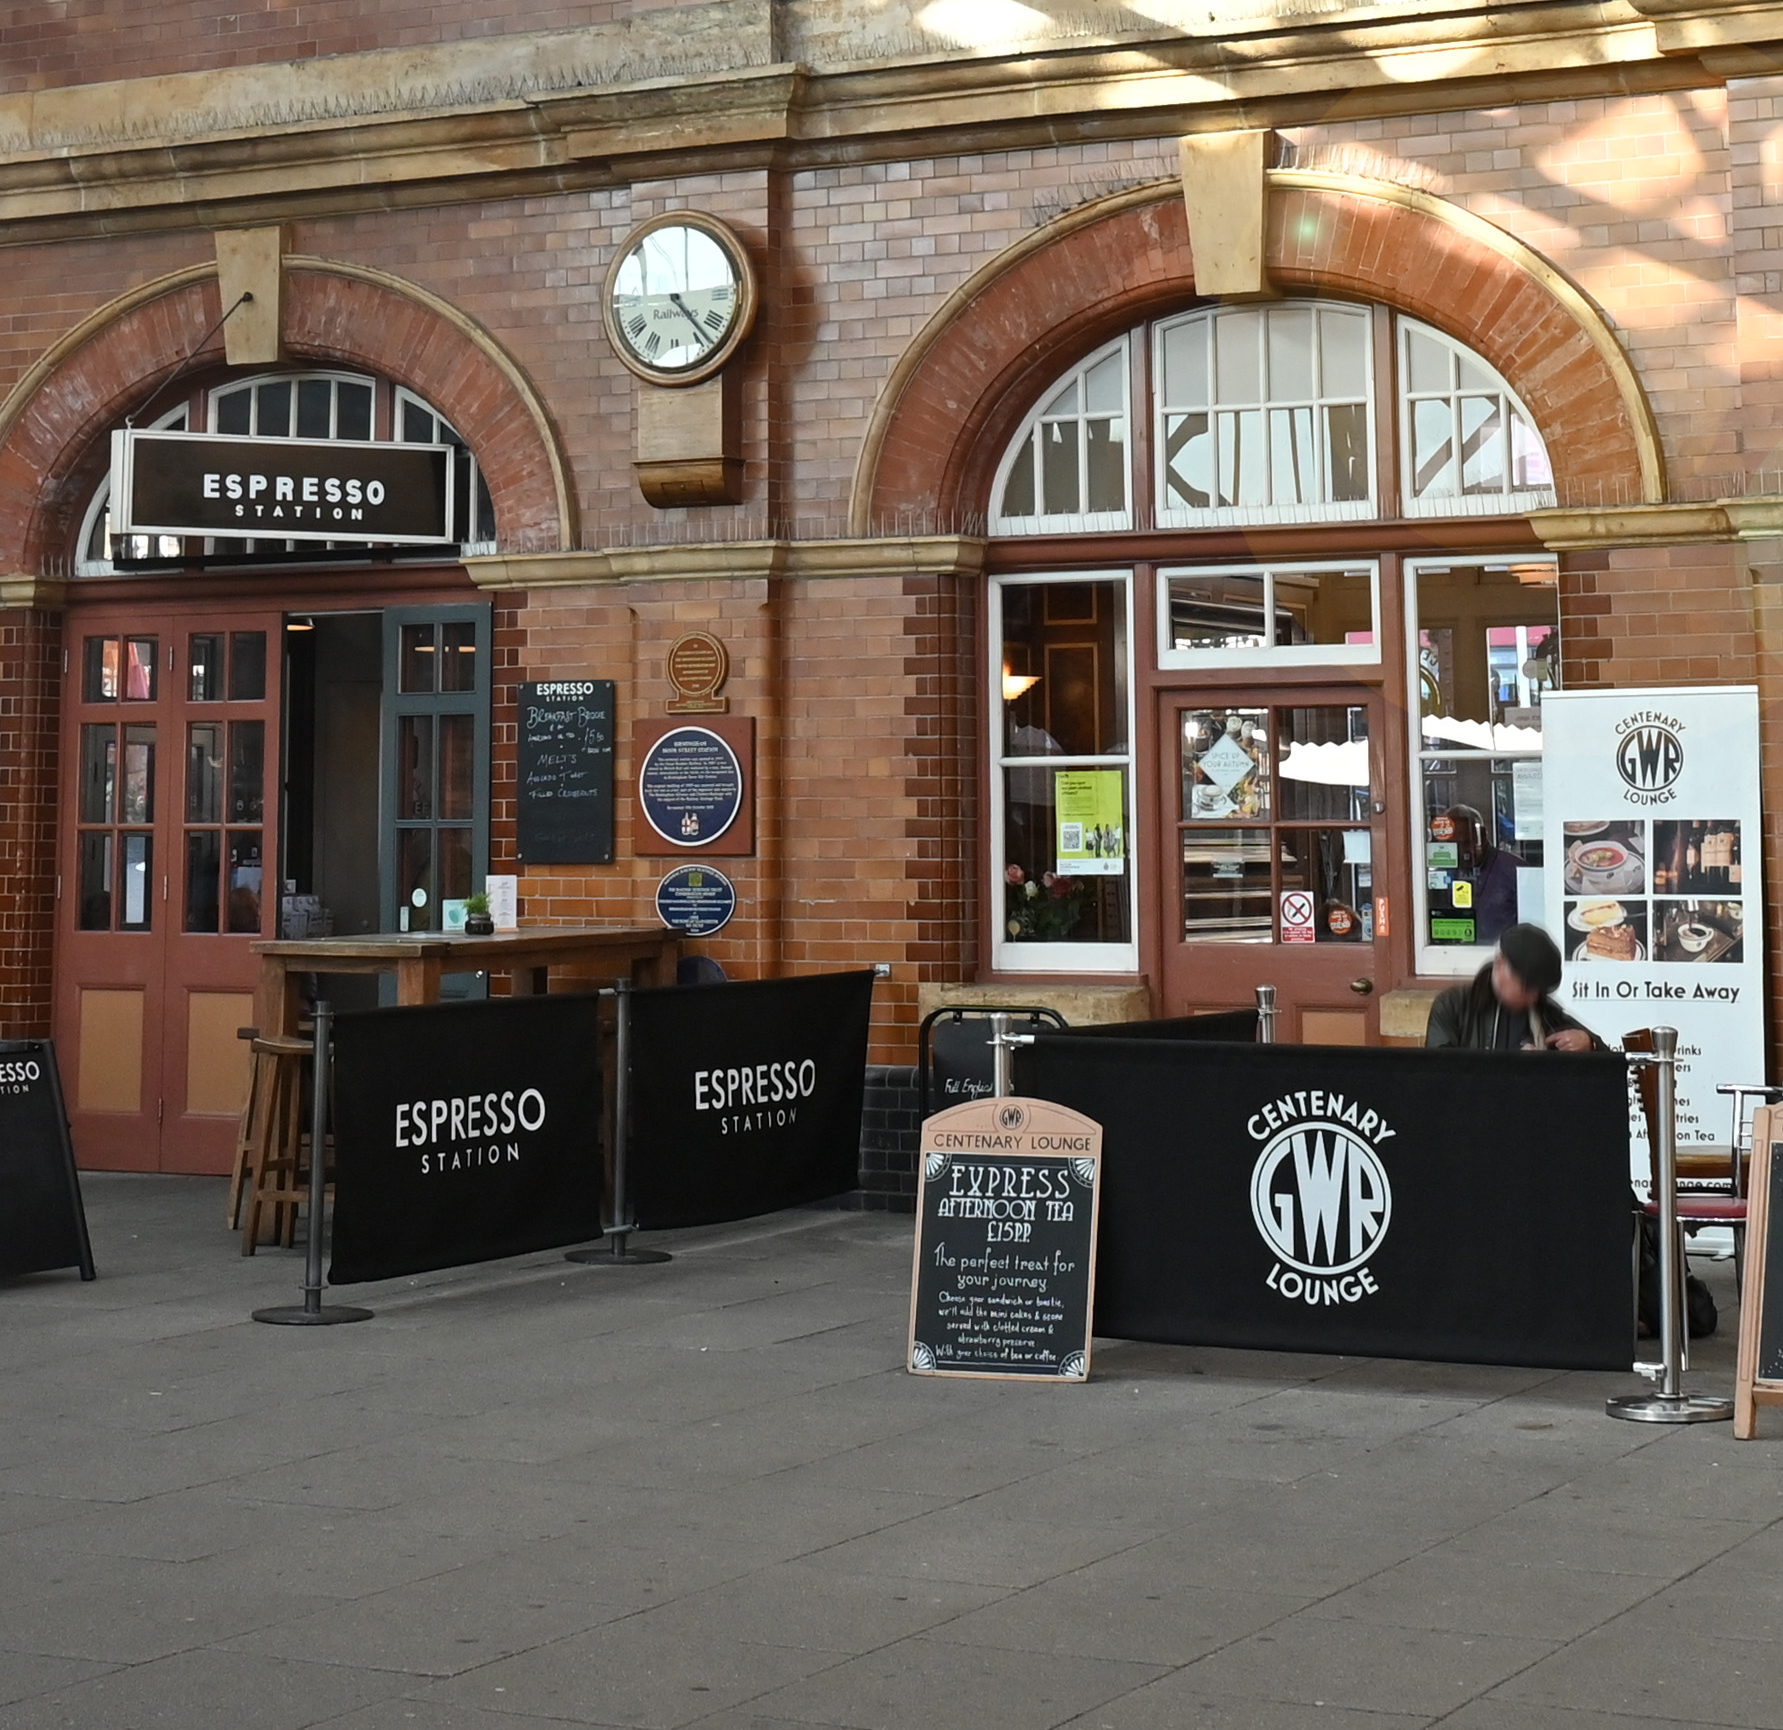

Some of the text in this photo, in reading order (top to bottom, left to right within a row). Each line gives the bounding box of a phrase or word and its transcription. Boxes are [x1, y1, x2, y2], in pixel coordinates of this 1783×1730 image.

[653, 307, 699, 321] Railways
[203, 474, 386, 506] ESPRESSO
[234, 505, 364, 521] STATION
[536, 682, 594, 696] ESPRESSO
[1615, 711, 1686, 736] CENTENARY
[1620, 728, 1680, 789] GWR
[1624, 788, 1677, 806] LOUNGE
[1378, 898, 1386, 925] PUSH
[1572, 981, 1740, 1003] Sit In Or Take Away
[1677, 1044, 1702, 1056] rinks
[695, 1058, 816, 1112] ESPRESSO
[395, 1088, 546, 1148] ESPRESSO
[721, 1107, 798, 1136] STATION
[1001, 1107, 1021, 1127] GWR
[1247, 1090, 1396, 1144] CENTENARY
[934, 1134, 1091, 1151] CENTENARY LOUNGE
[1694, 1131, 1715, 1142] Tea
[421, 1142, 520, 1175] STATION
[949, 1166, 1070, 1199] EXPRESS
[937, 1198, 1074, 1221] AFTERNOON TEA
[1255, 1133, 1384, 1266] GWR
[934, 1242, 1075, 1276] The perfect treat for
[957, 1274, 1048, 1294] your journey
[1265, 1261, 1380, 1306] LOUNGE
[938, 1291, 1023, 1306] Choose sandwich
[976, 1306, 1032, 1320] the cakes
[946, 1319, 1046, 1333] served clotted cream
